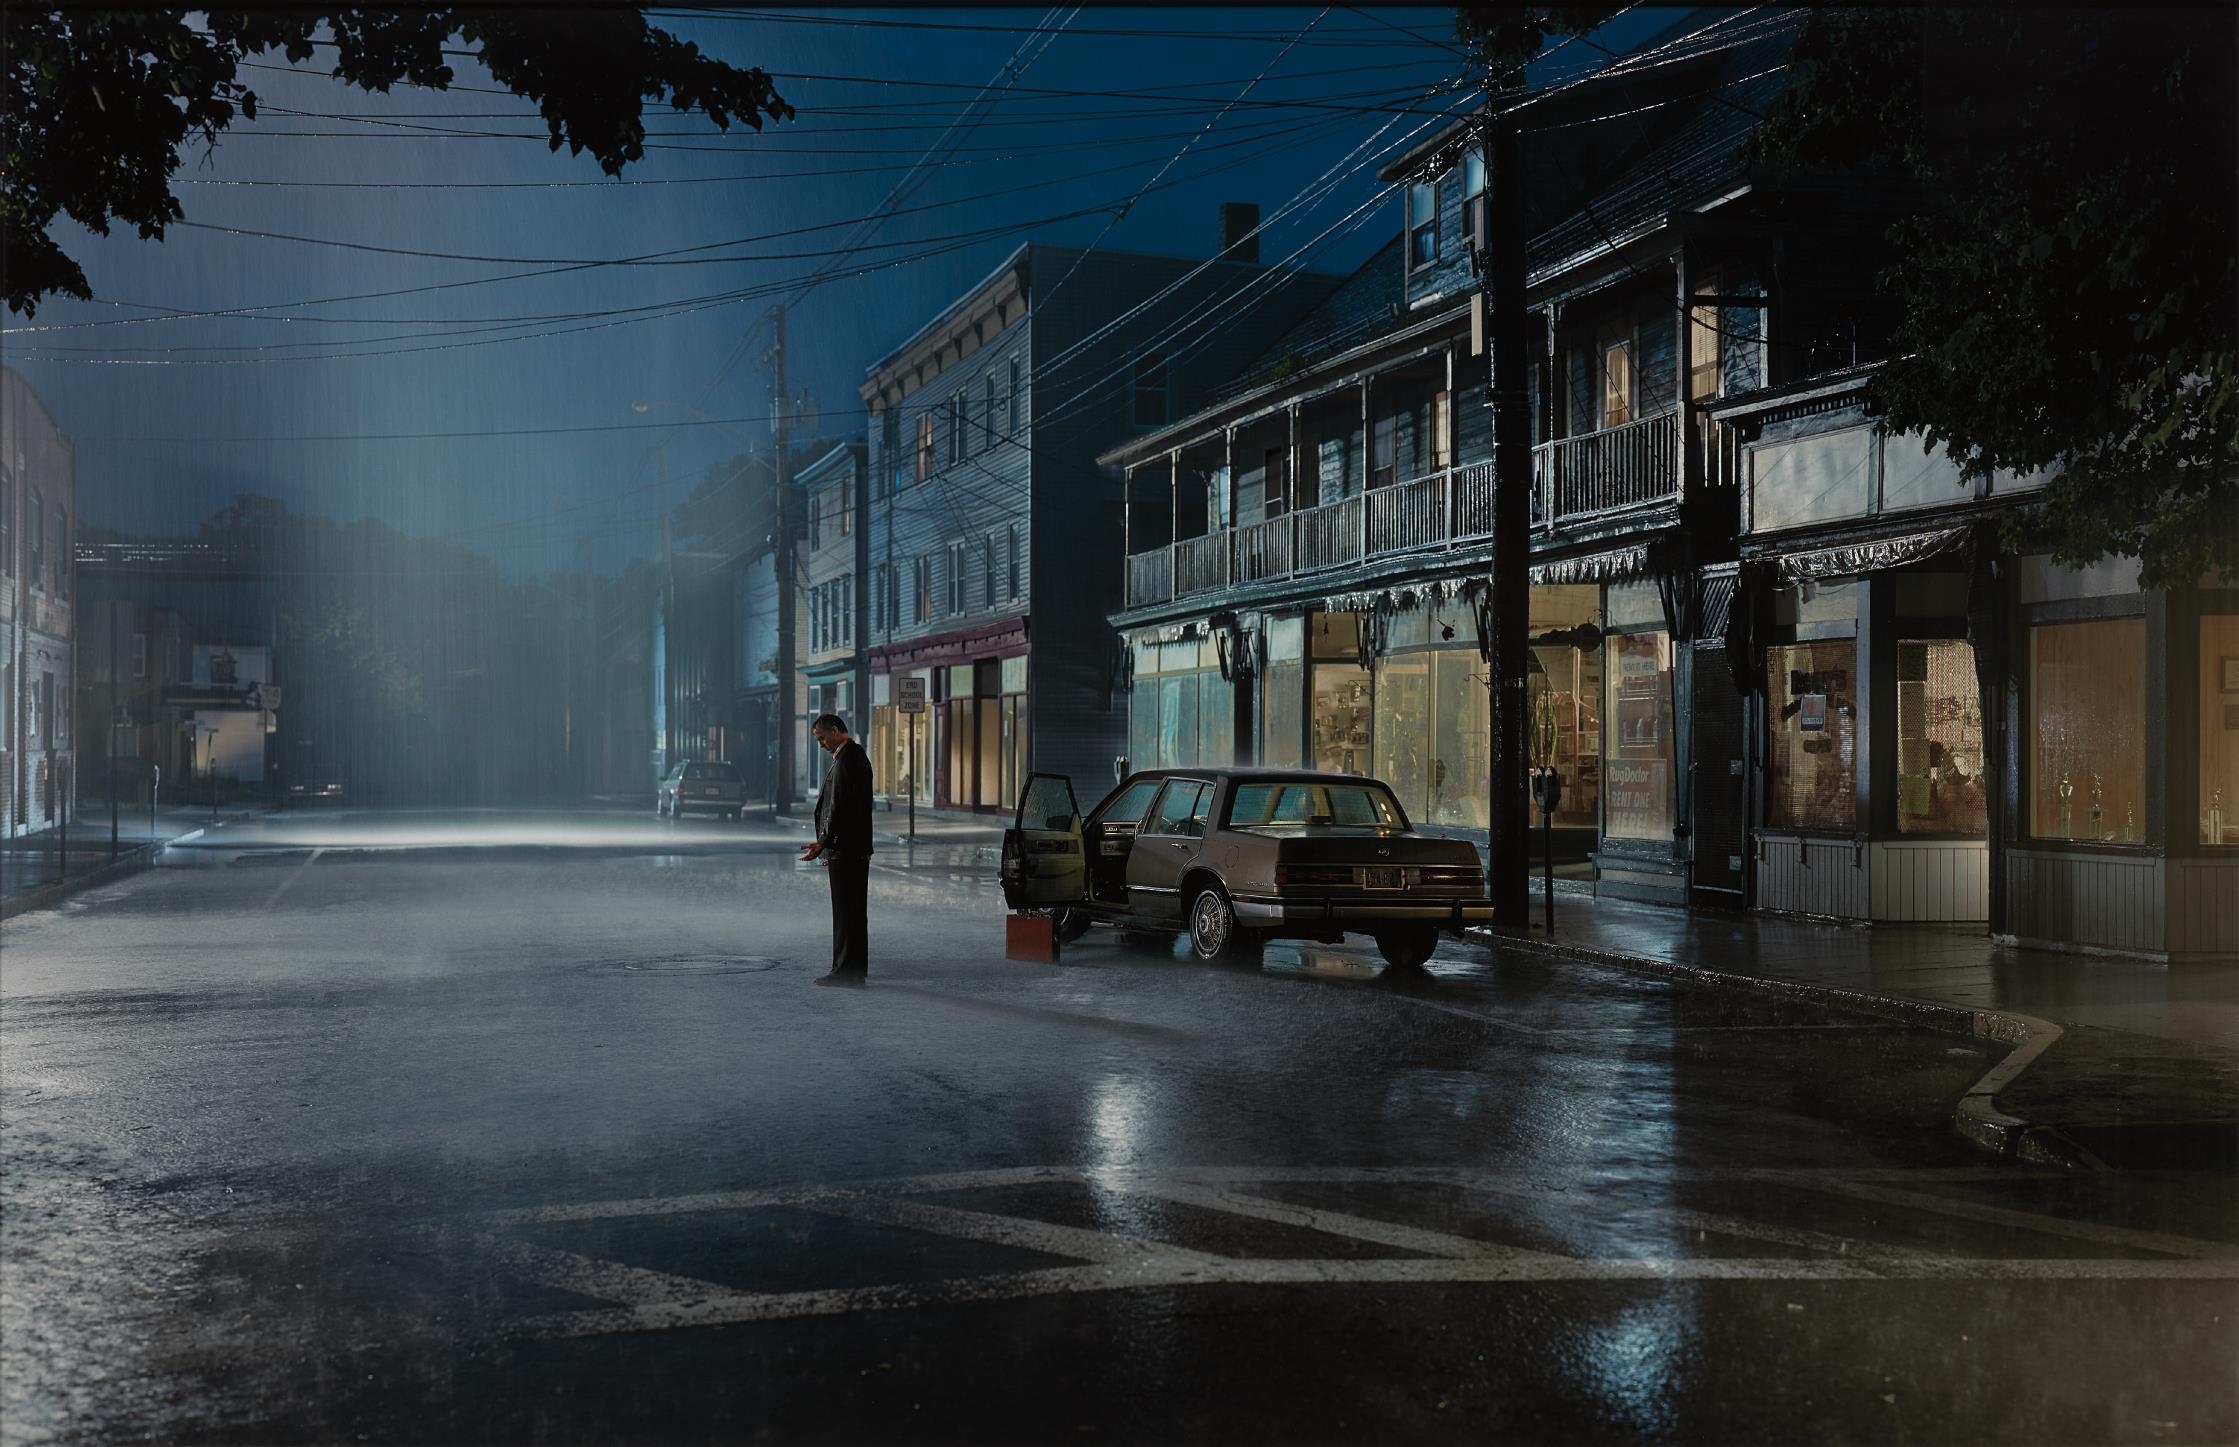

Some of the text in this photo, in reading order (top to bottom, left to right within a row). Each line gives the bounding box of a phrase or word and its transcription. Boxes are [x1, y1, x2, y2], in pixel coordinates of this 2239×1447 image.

[1612, 791, 1650, 808] RENT ONE
[1612, 811, 1648, 834] HERE!
